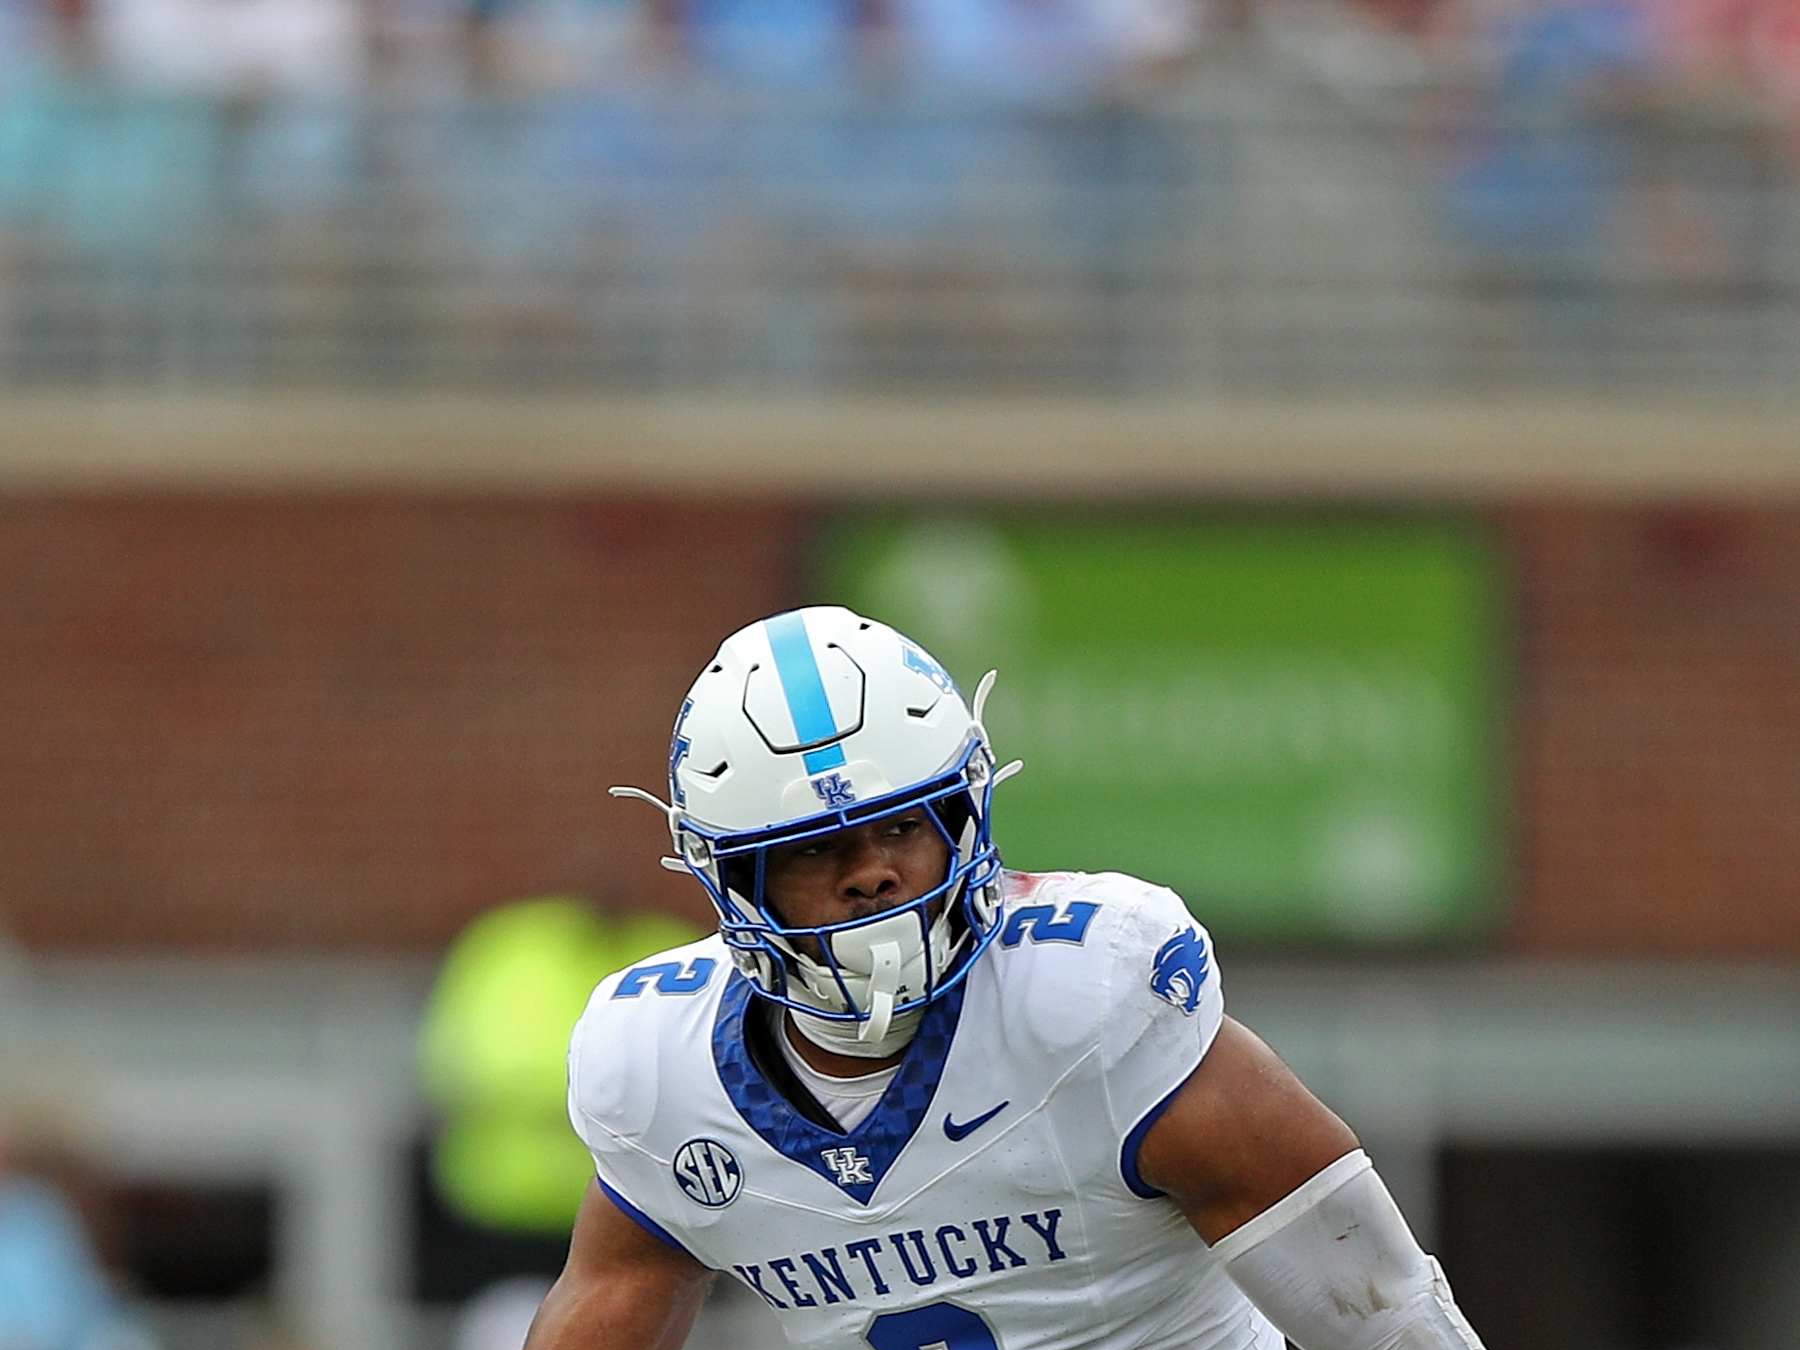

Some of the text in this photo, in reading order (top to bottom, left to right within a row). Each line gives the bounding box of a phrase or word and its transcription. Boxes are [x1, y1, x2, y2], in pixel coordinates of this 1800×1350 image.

[810, 772, 855, 808] UK
[1000, 900, 1104, 951] 2
[611, 957, 716, 1000] 2
[674, 1140, 742, 1206] SEC
[821, 1146, 873, 1185] UK
[733, 1208, 1068, 1310] KENTUCKY
